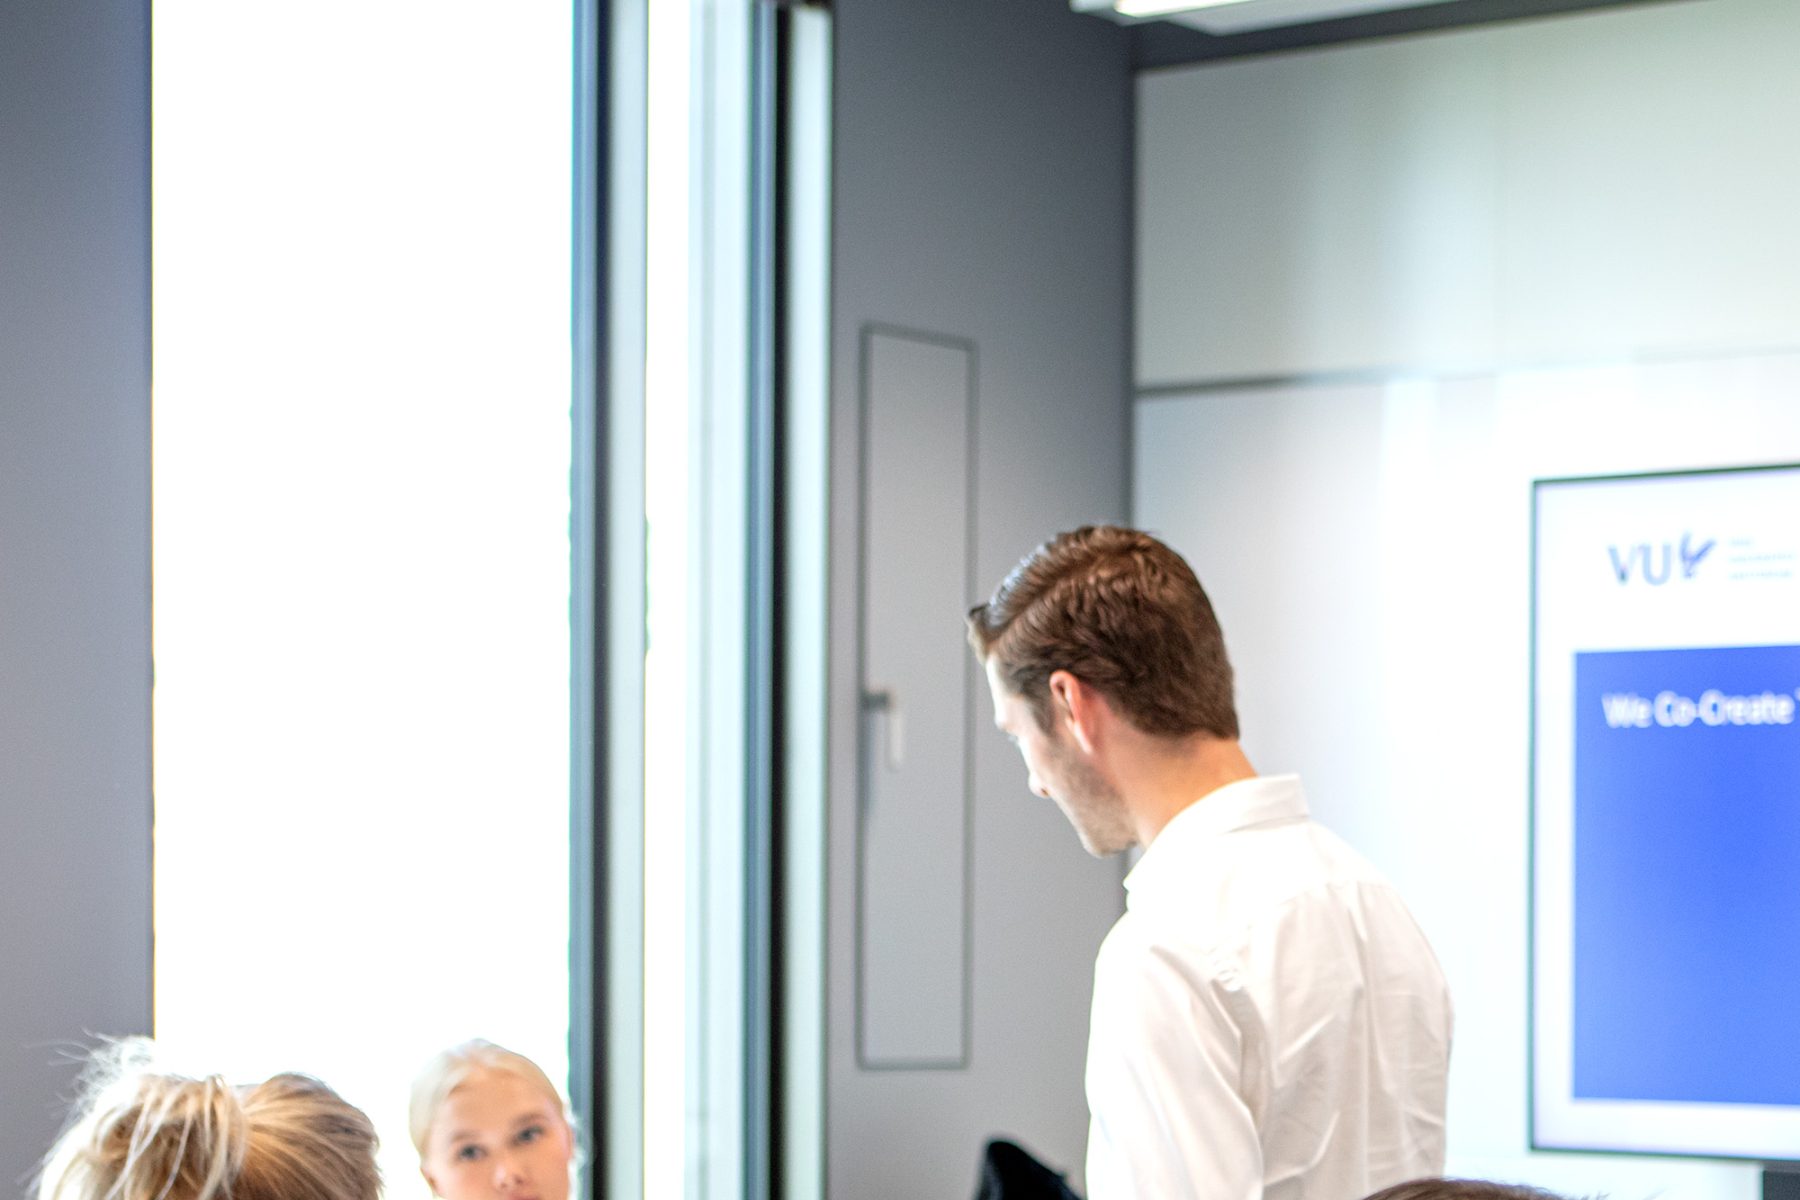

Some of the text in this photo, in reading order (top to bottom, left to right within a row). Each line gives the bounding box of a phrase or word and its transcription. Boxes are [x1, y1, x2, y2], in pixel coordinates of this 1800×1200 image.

[1606, 542, 1672, 587] VU
[1600, 691, 1652, 729] We
[1654, 688, 1794, 728] Co-Create
